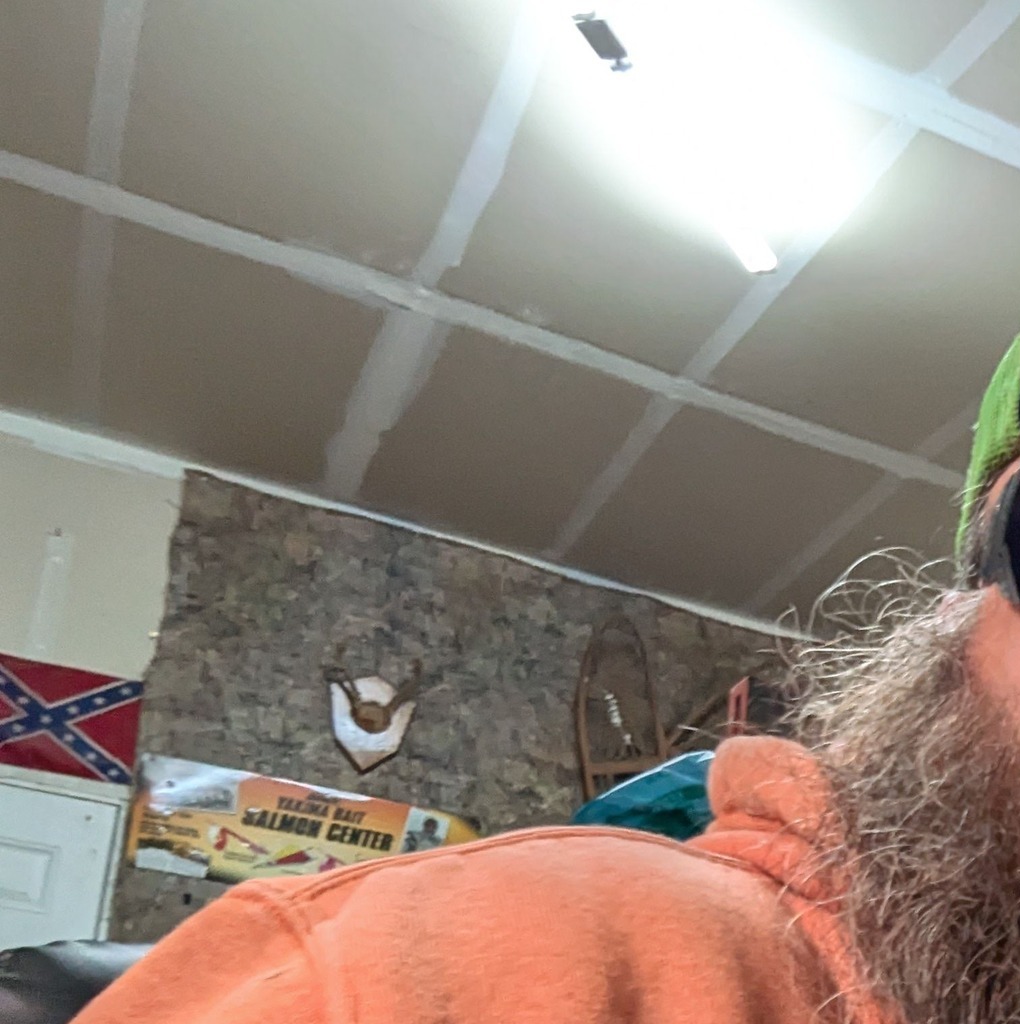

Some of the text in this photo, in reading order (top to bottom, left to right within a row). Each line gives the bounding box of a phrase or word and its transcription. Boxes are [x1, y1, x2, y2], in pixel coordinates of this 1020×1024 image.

[277, 796, 329, 818] YAKIMA
[333, 807, 367, 825] BAIT
[241, 808, 394, 852] SALMON CENTER
